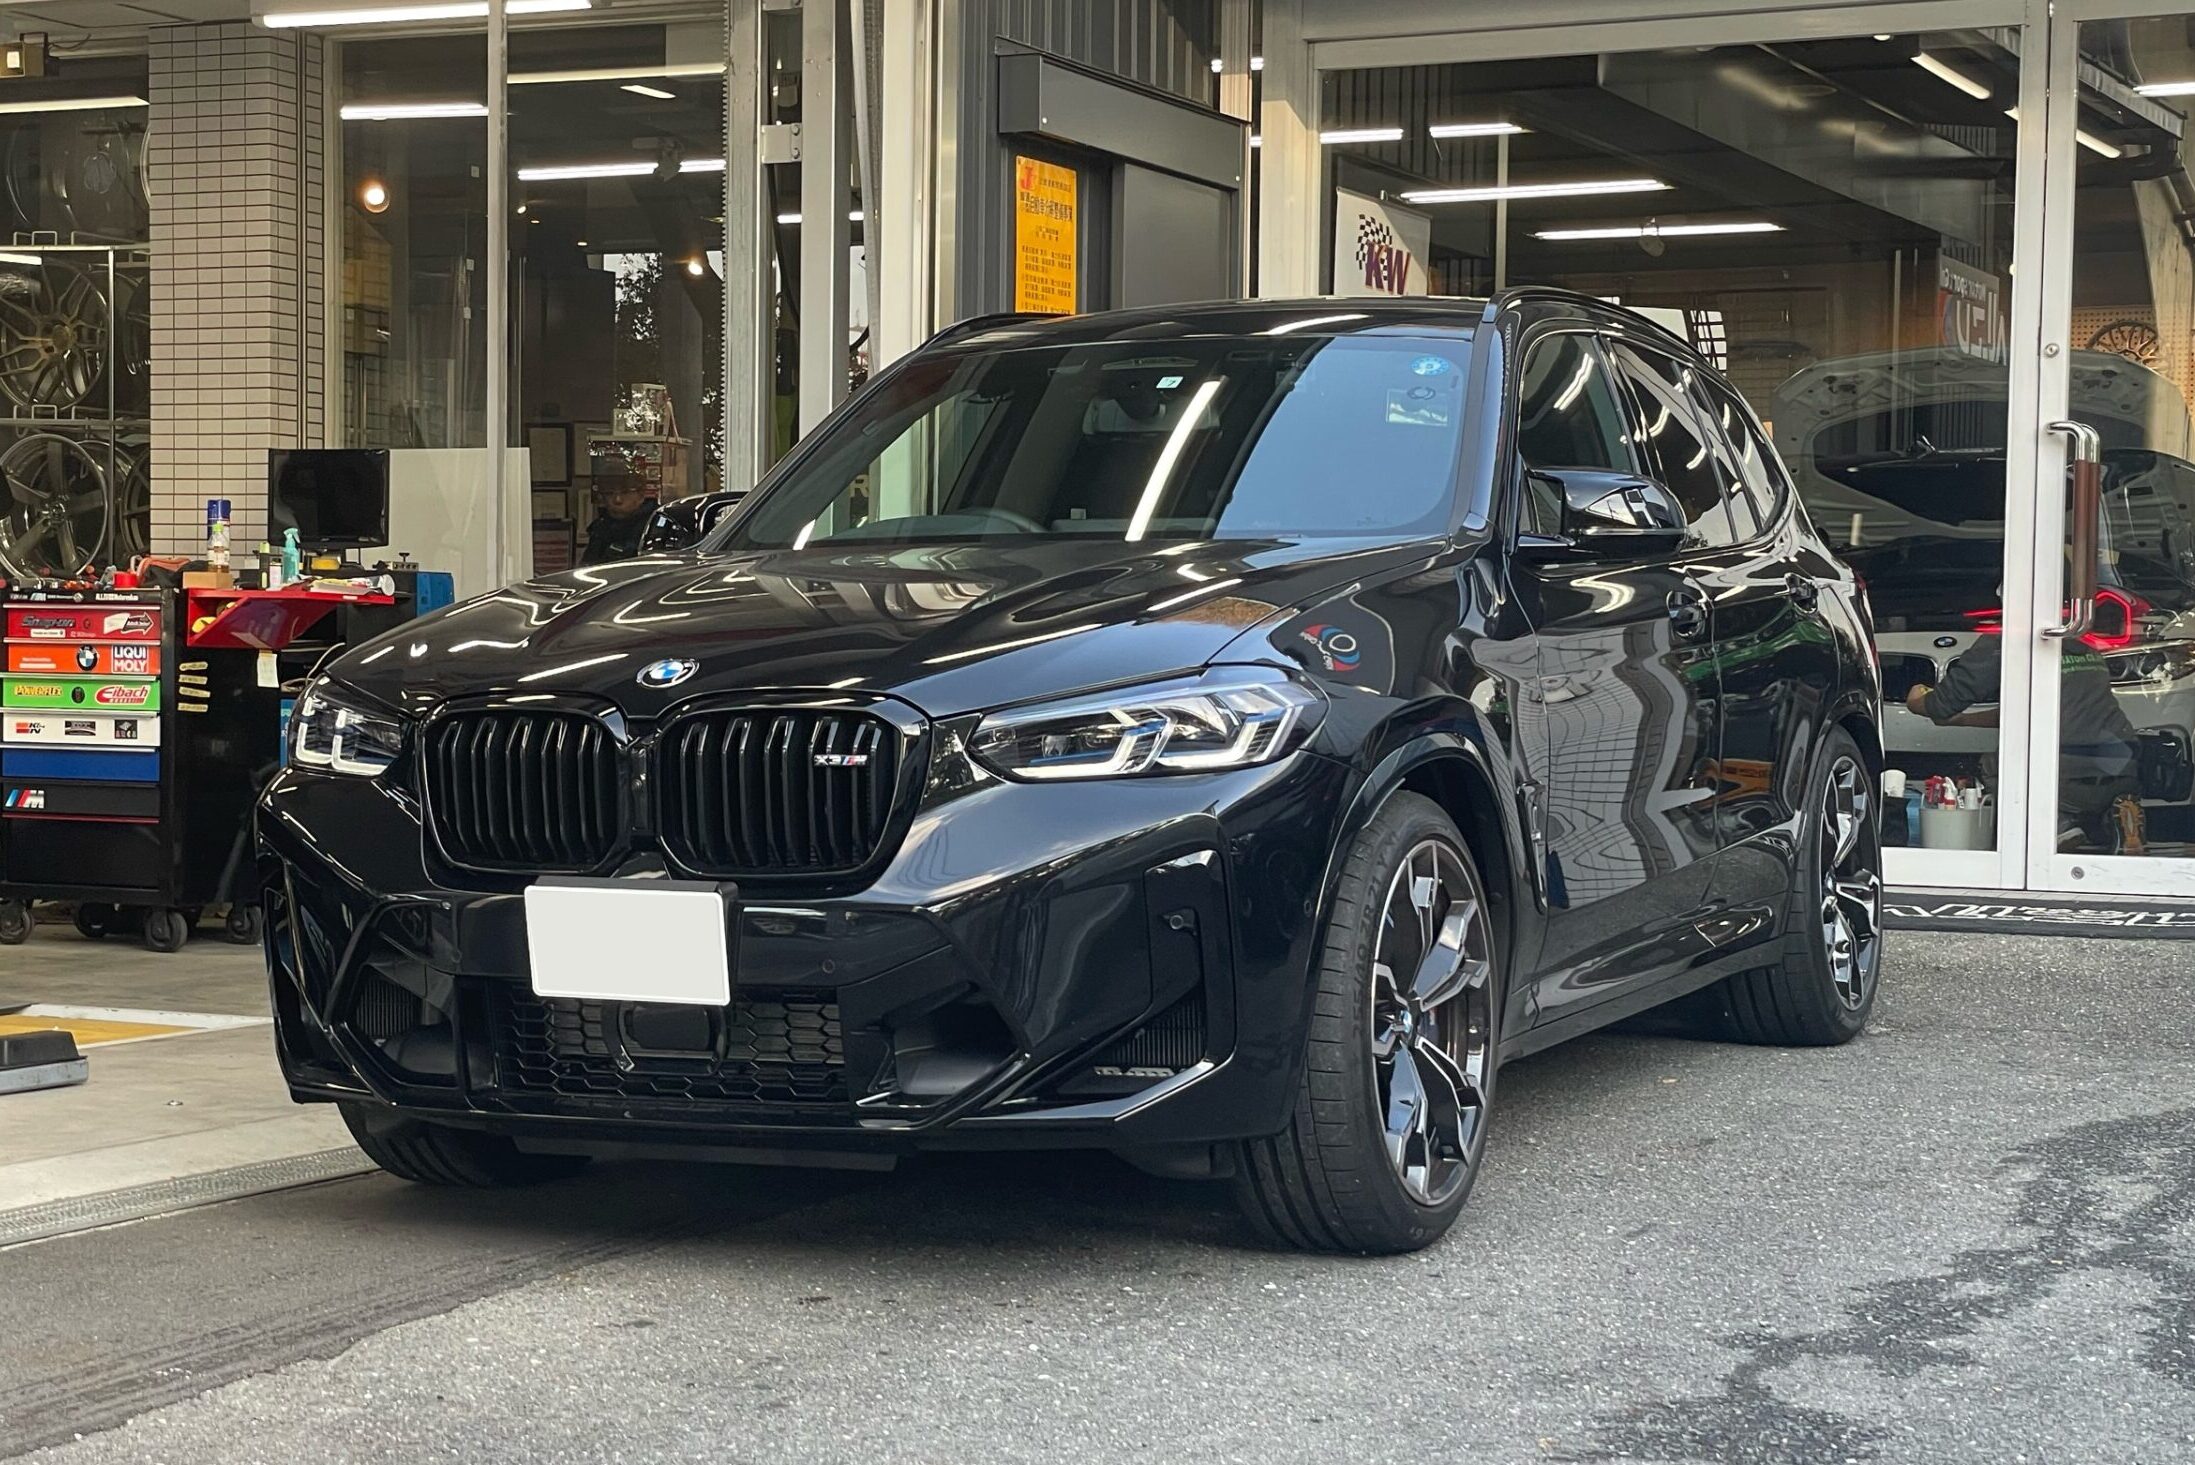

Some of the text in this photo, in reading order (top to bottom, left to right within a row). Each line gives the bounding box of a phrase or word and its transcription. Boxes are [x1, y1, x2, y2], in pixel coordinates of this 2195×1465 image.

[1365, 240, 1411, 295] KW
[114, 646, 147, 658] LIQUI
[114, 659, 147, 671] MOLY
[96, 686, 149, 703] Eibach
